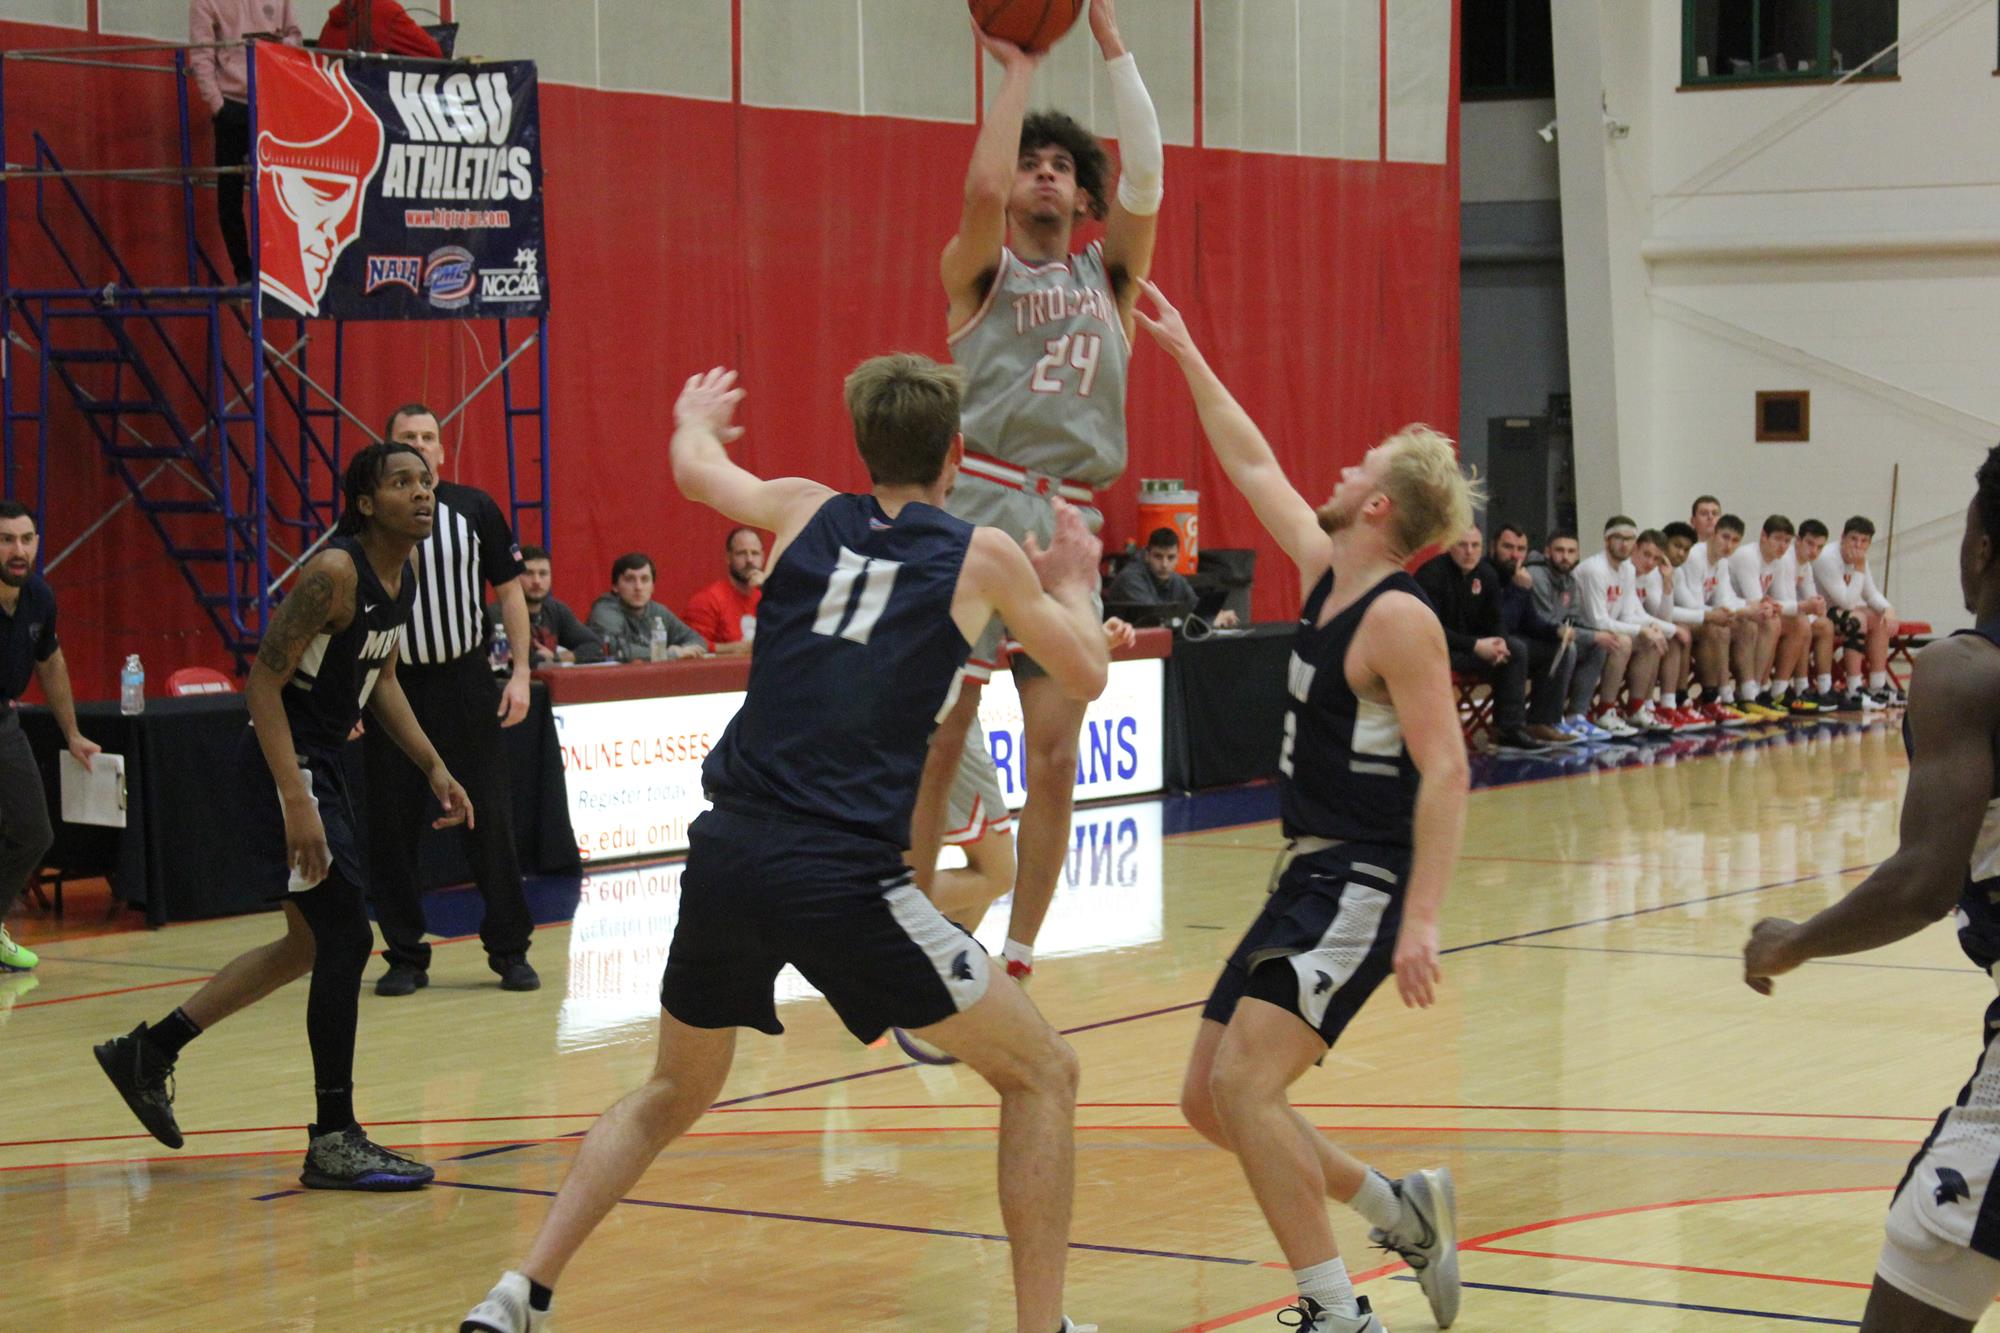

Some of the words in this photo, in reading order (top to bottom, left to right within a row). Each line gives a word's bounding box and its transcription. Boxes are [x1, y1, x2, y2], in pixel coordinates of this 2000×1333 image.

[388, 71, 513, 146] HLGU
[382, 143, 533, 201] ATHLETICS
[369, 259, 420, 289] NAIA
[482, 273, 541, 297] NCCAA
[1030, 332, 1102, 397] 24
[810, 545, 904, 646] 11
[560, 741, 624, 771] ONLINE
[630, 732, 711, 766] CLASSES
